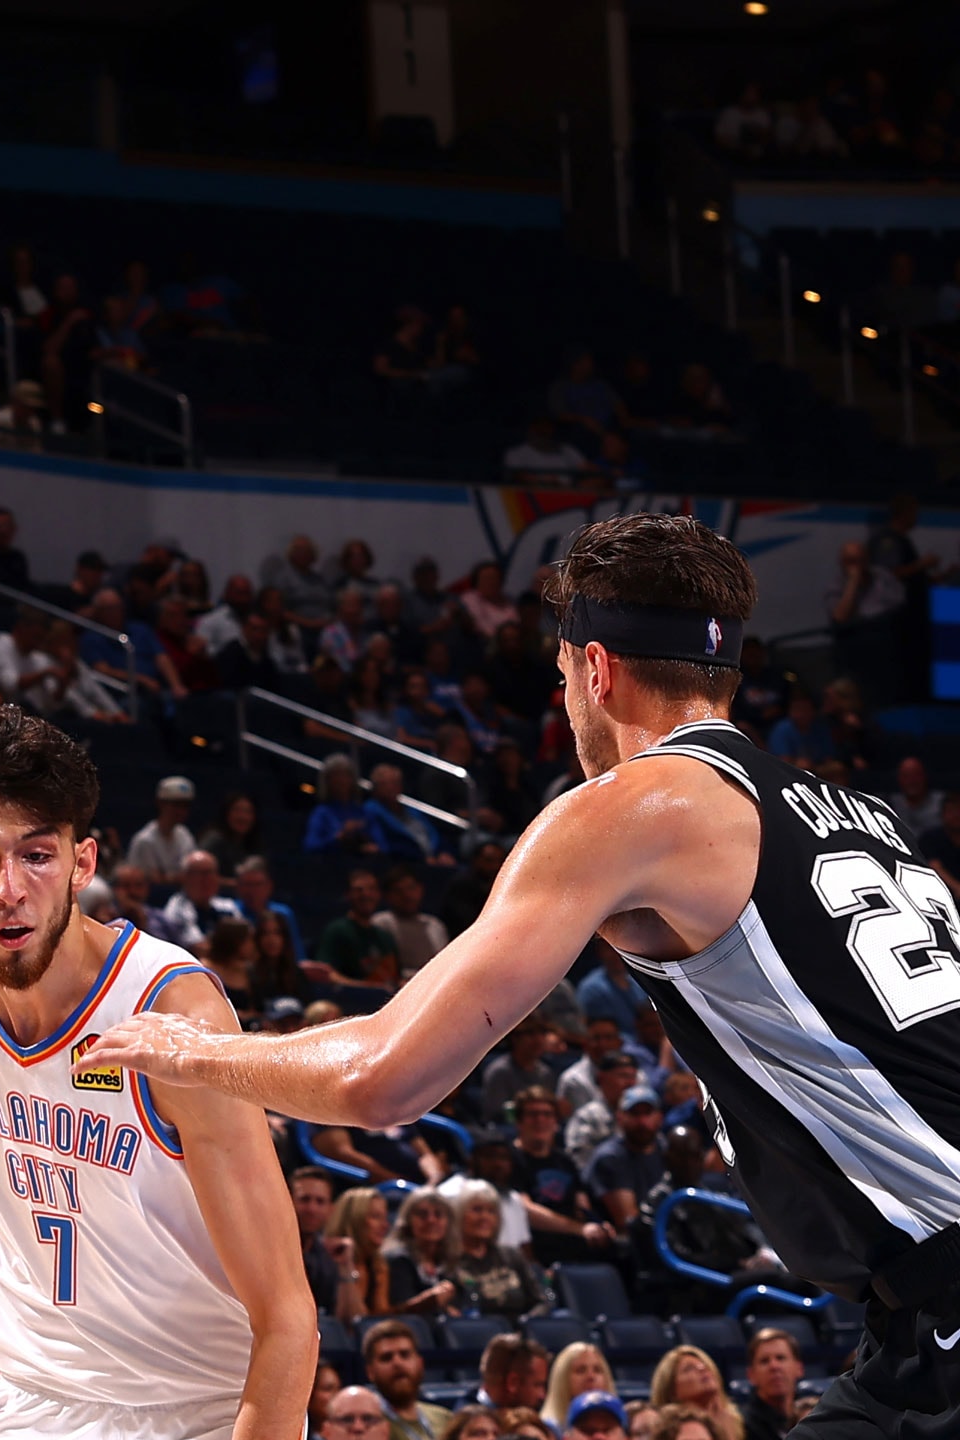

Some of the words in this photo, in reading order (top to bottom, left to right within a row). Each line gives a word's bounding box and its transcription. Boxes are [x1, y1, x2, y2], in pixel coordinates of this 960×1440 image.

[780, 782, 913, 857] COLLINS
[5, 1149, 82, 1213] CITY
[32, 1210, 78, 1306] 7
